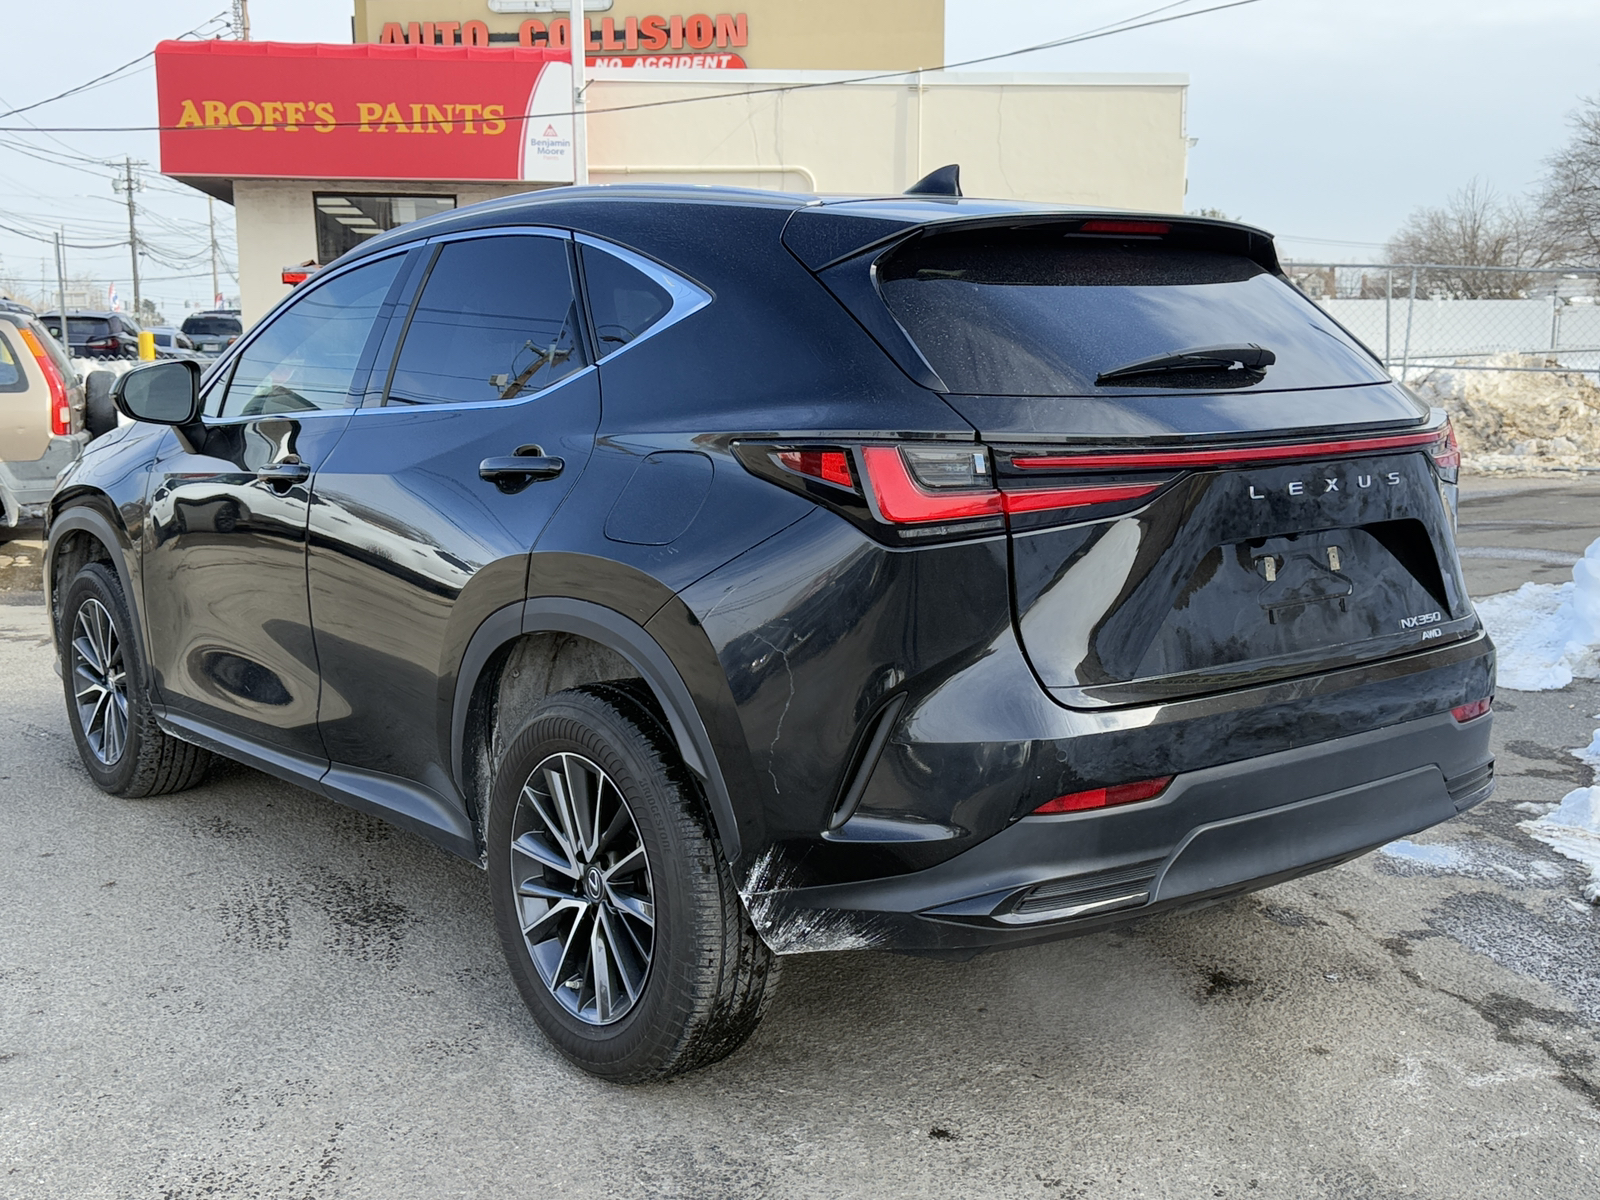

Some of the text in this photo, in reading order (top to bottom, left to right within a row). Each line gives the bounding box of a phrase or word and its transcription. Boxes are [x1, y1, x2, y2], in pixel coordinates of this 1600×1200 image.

[380, 13, 748, 51] AUTO COLLISION
[595, 55, 732, 68] NO ACCIDENT
[175, 99, 507, 135] ABOFF'S PAINTS
[530, 138, 571, 148] Benjamin
[537, 147, 565, 155] Moore
[1250, 472, 1400, 500] LEXUS
[1401, 611, 1442, 629] NX350
[1422, 628, 1442, 640] AWD
[638, 777, 672, 855] BRIDGESTONE
